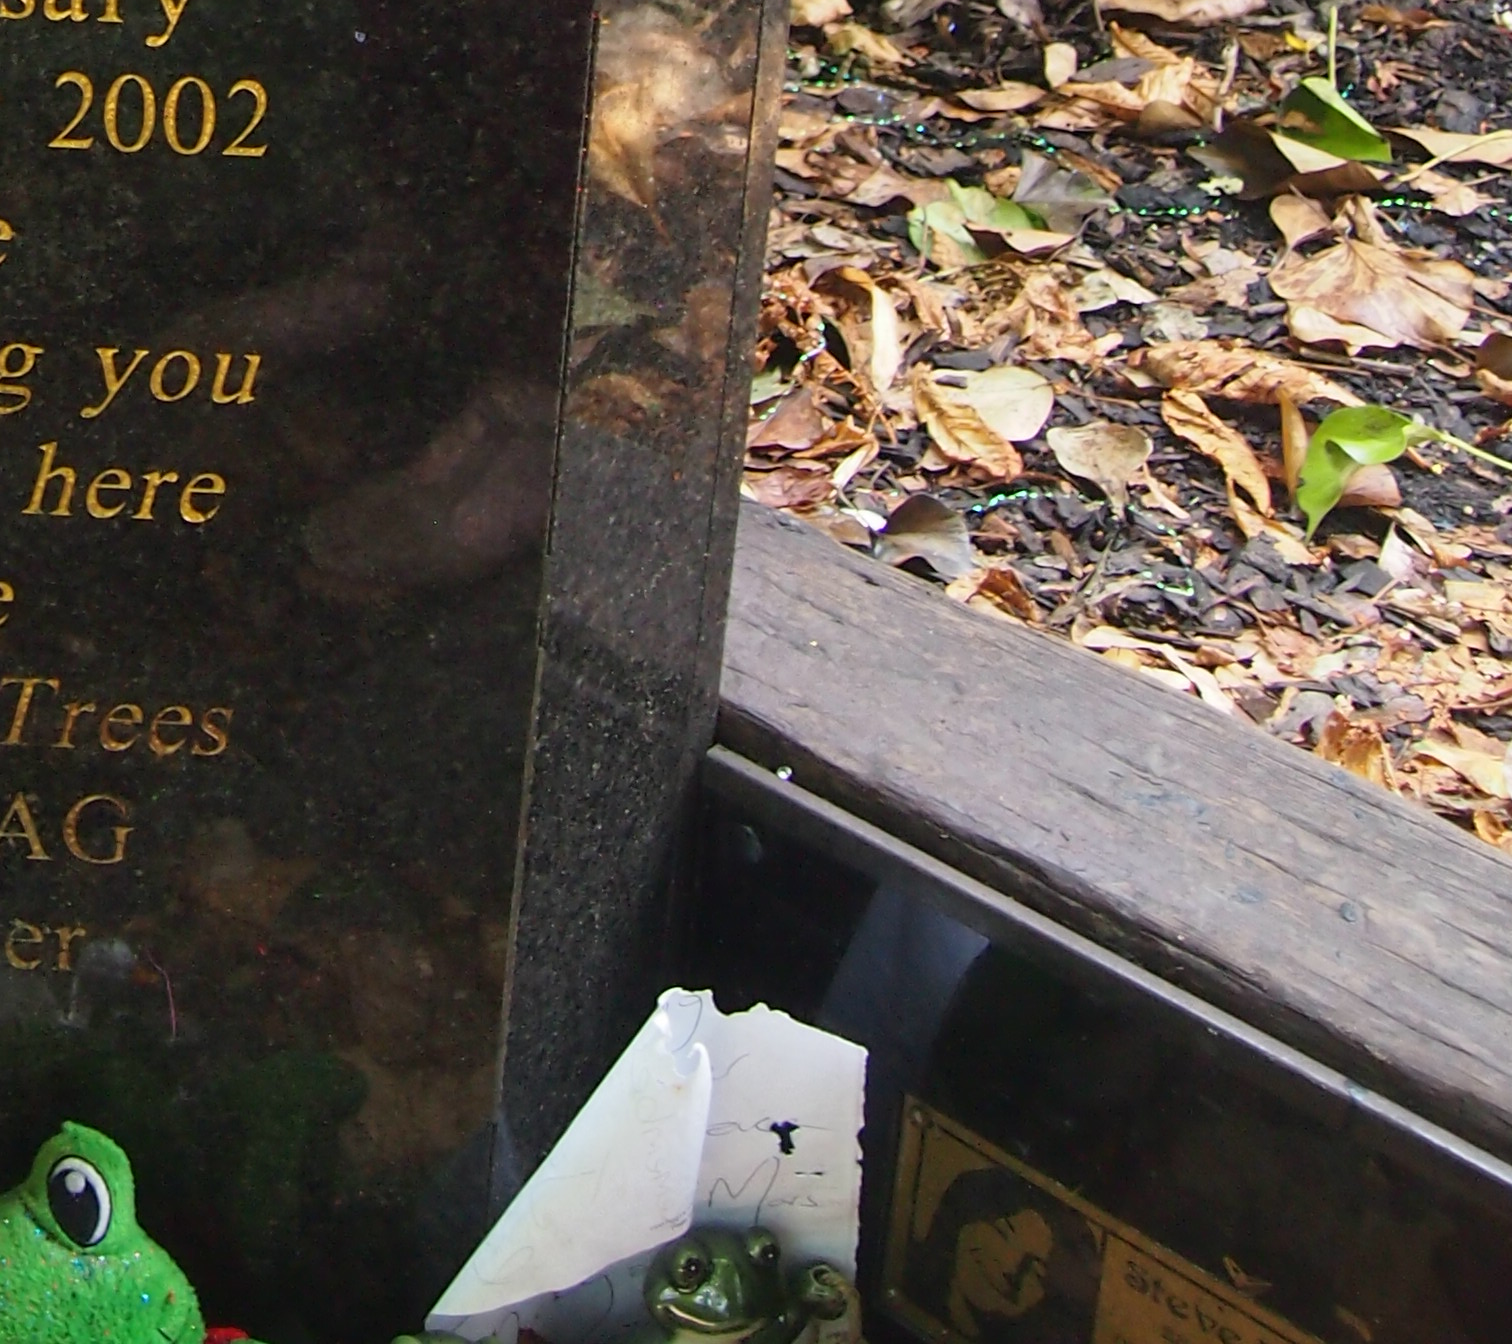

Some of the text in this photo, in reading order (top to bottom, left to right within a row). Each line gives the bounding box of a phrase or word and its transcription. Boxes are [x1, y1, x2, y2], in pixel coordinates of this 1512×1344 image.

[48, 68, 269, 157] 2002
[80, 345, 262, 418] you
[22, 440, 227, 524] here
[0, 674, 233, 759] Trees
